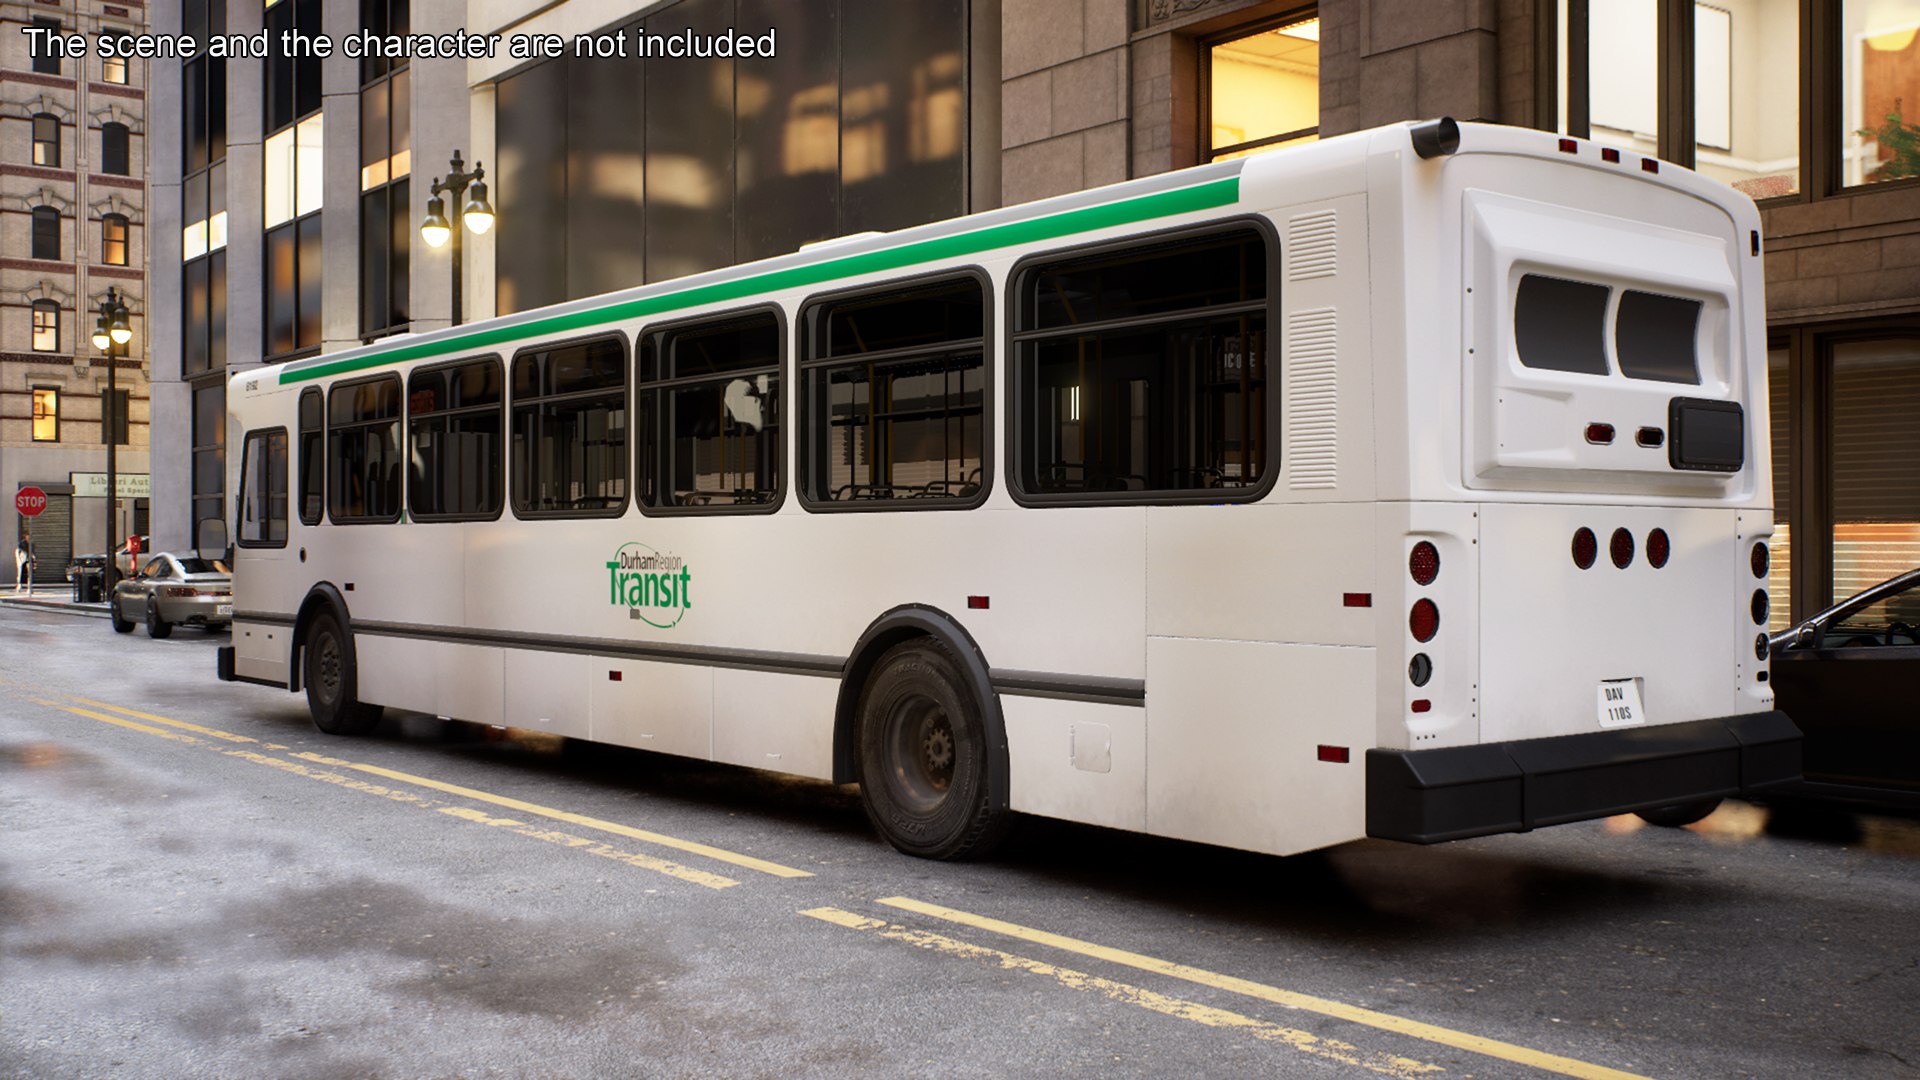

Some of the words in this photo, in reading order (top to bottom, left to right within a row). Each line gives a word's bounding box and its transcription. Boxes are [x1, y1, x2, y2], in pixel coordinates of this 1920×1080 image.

[17, 495, 45, 508] STOP
[606, 561, 691, 609] Transit
[1604, 687, 1623, 701] DAV
